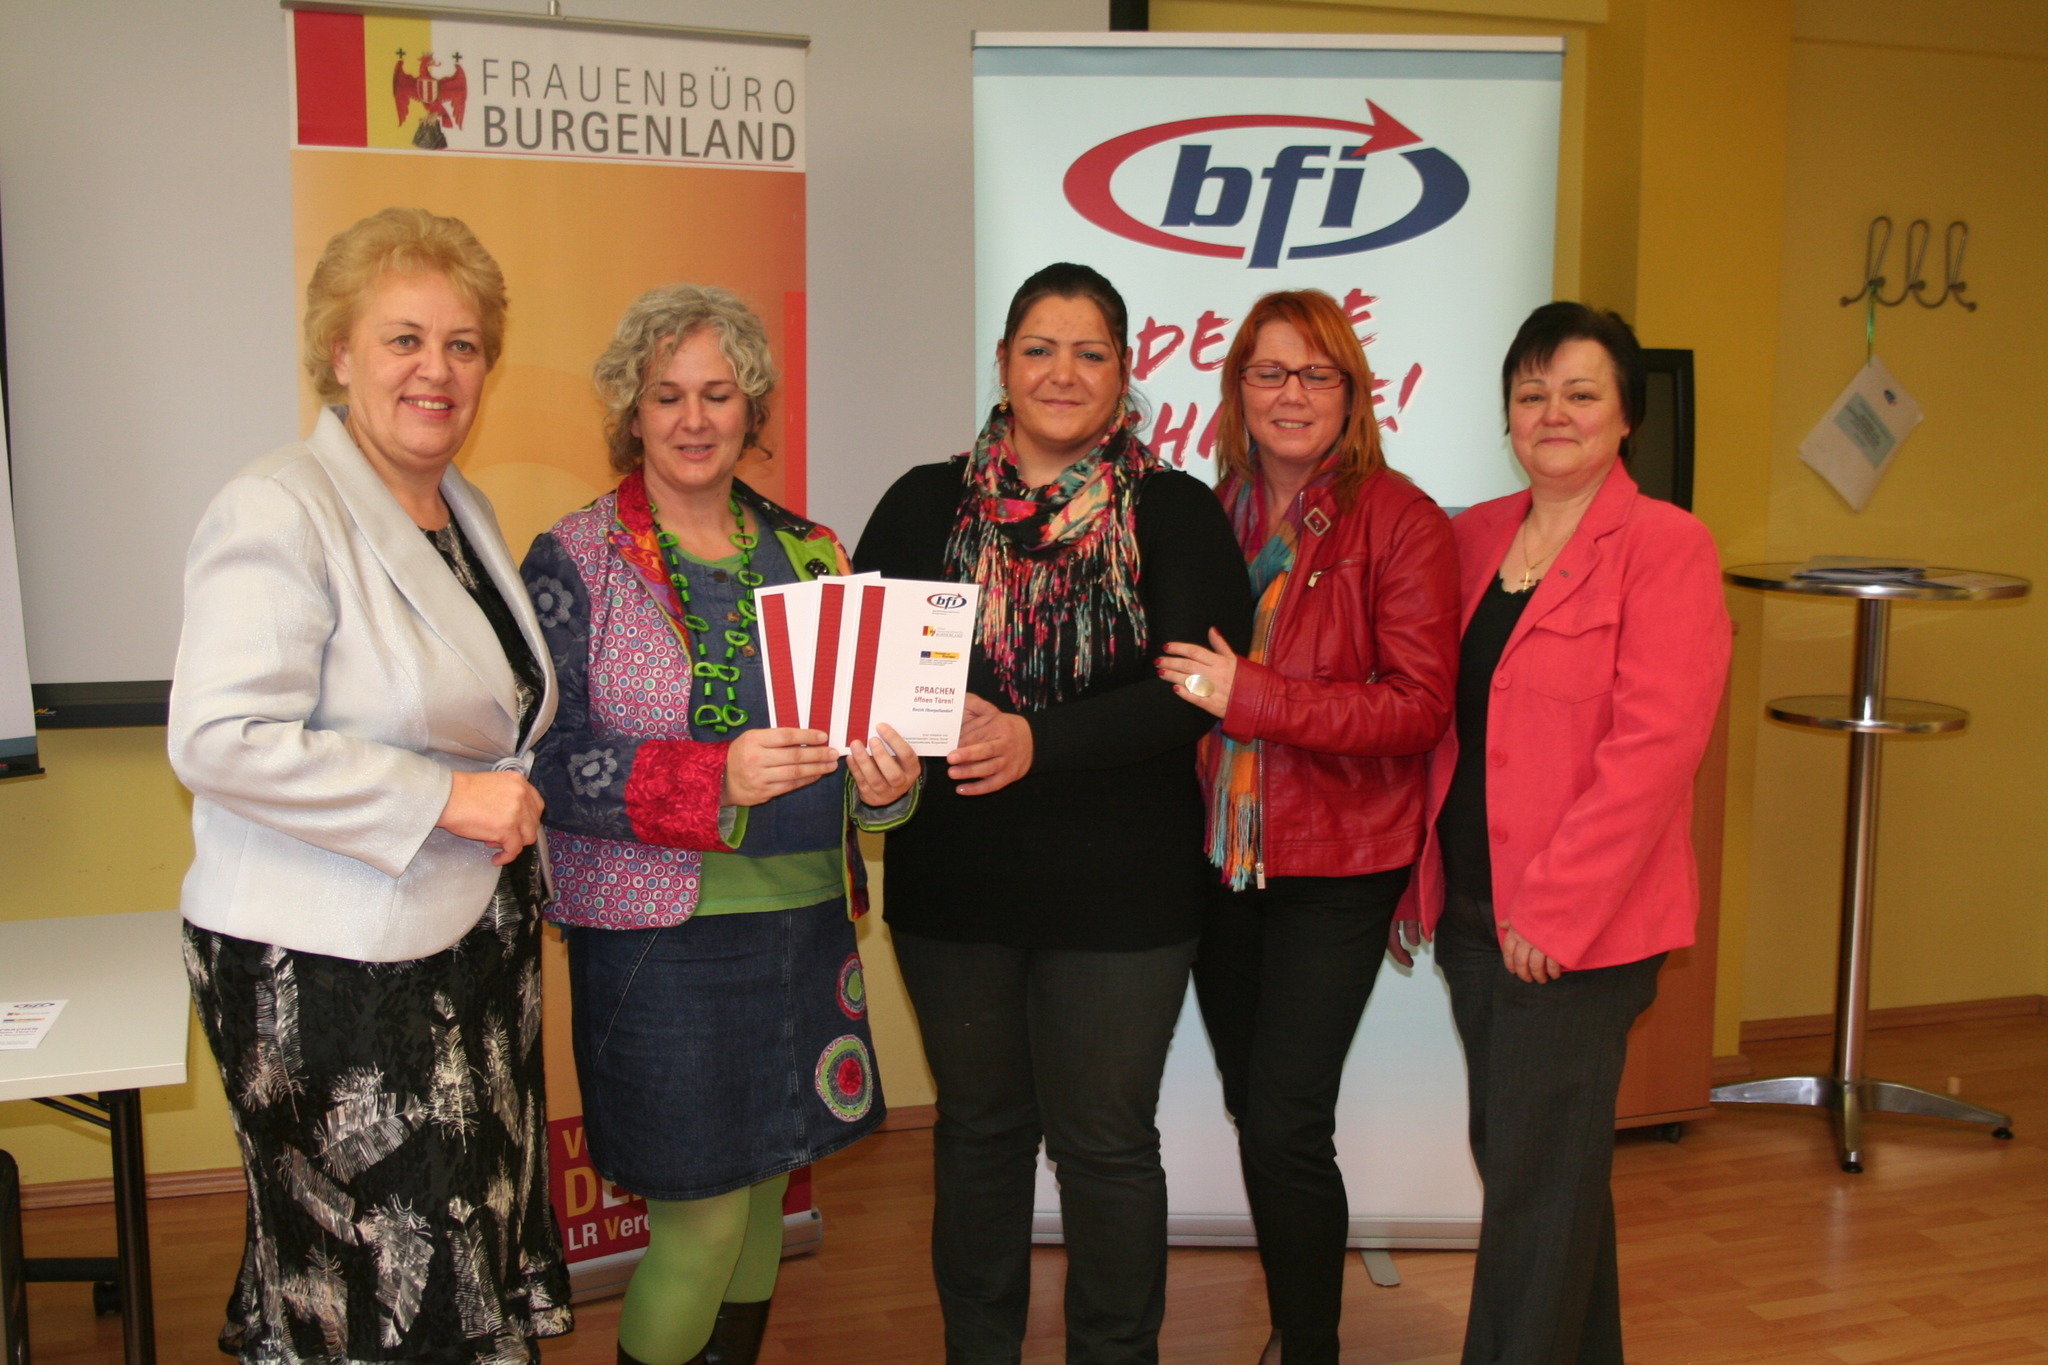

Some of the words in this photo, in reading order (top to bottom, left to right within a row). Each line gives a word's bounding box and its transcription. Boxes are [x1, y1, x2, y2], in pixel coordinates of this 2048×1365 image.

[482, 58, 796, 115] FRAUENBÜRO
[483, 105, 796, 162] BURGENLAND
[1160, 144, 1368, 269] bfi
[936, 596, 957, 609] bfi
[914, 686, 956, 695] SPRACHEN
[568, 1222, 599, 1251] LR
